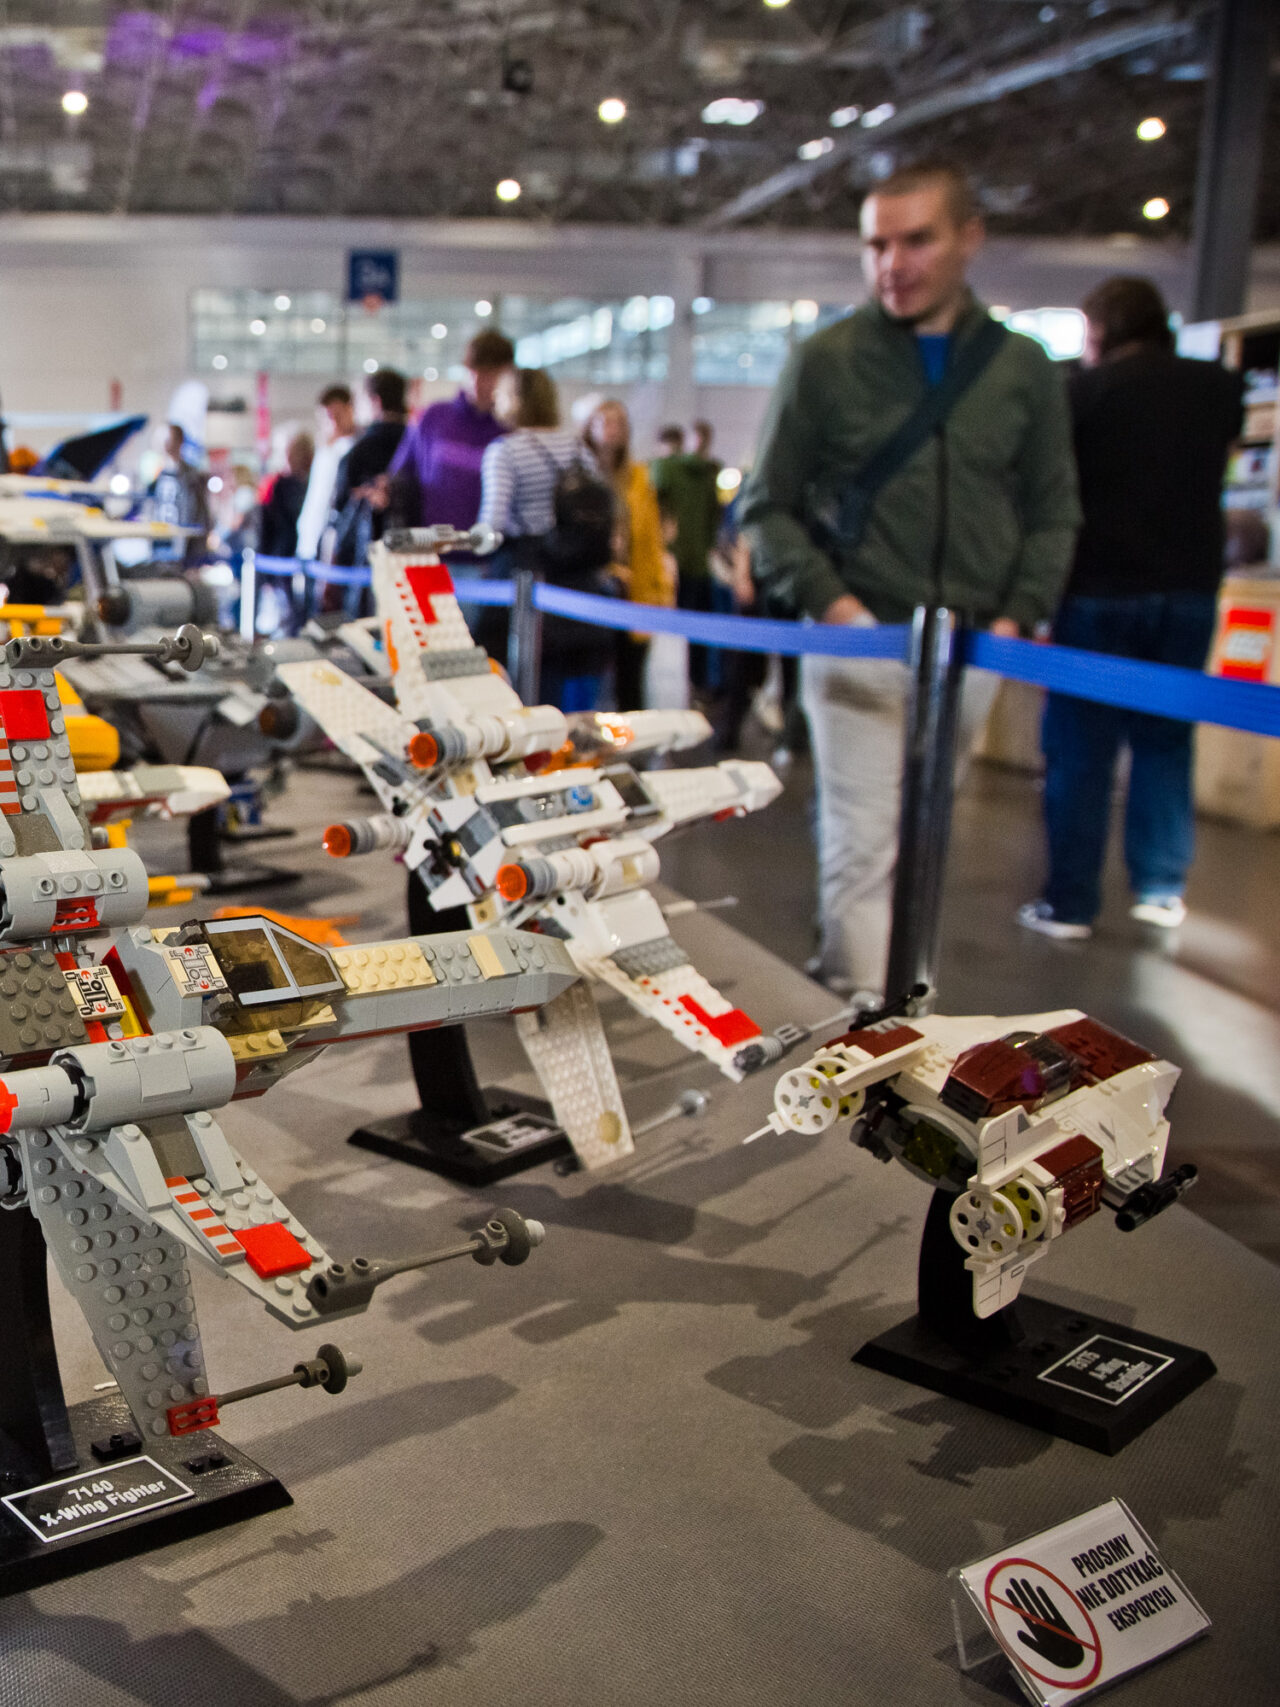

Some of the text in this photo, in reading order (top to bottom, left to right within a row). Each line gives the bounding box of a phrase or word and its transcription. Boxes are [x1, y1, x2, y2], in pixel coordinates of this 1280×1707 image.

[39, 1480, 167, 1527] X-Wing Fighter
[67, 1479, 115, 1501] 7140
[1071, 1533, 1135, 1578] PROSIMY
[1075, 1551, 1164, 1611] NIE DOTYKAĆ
